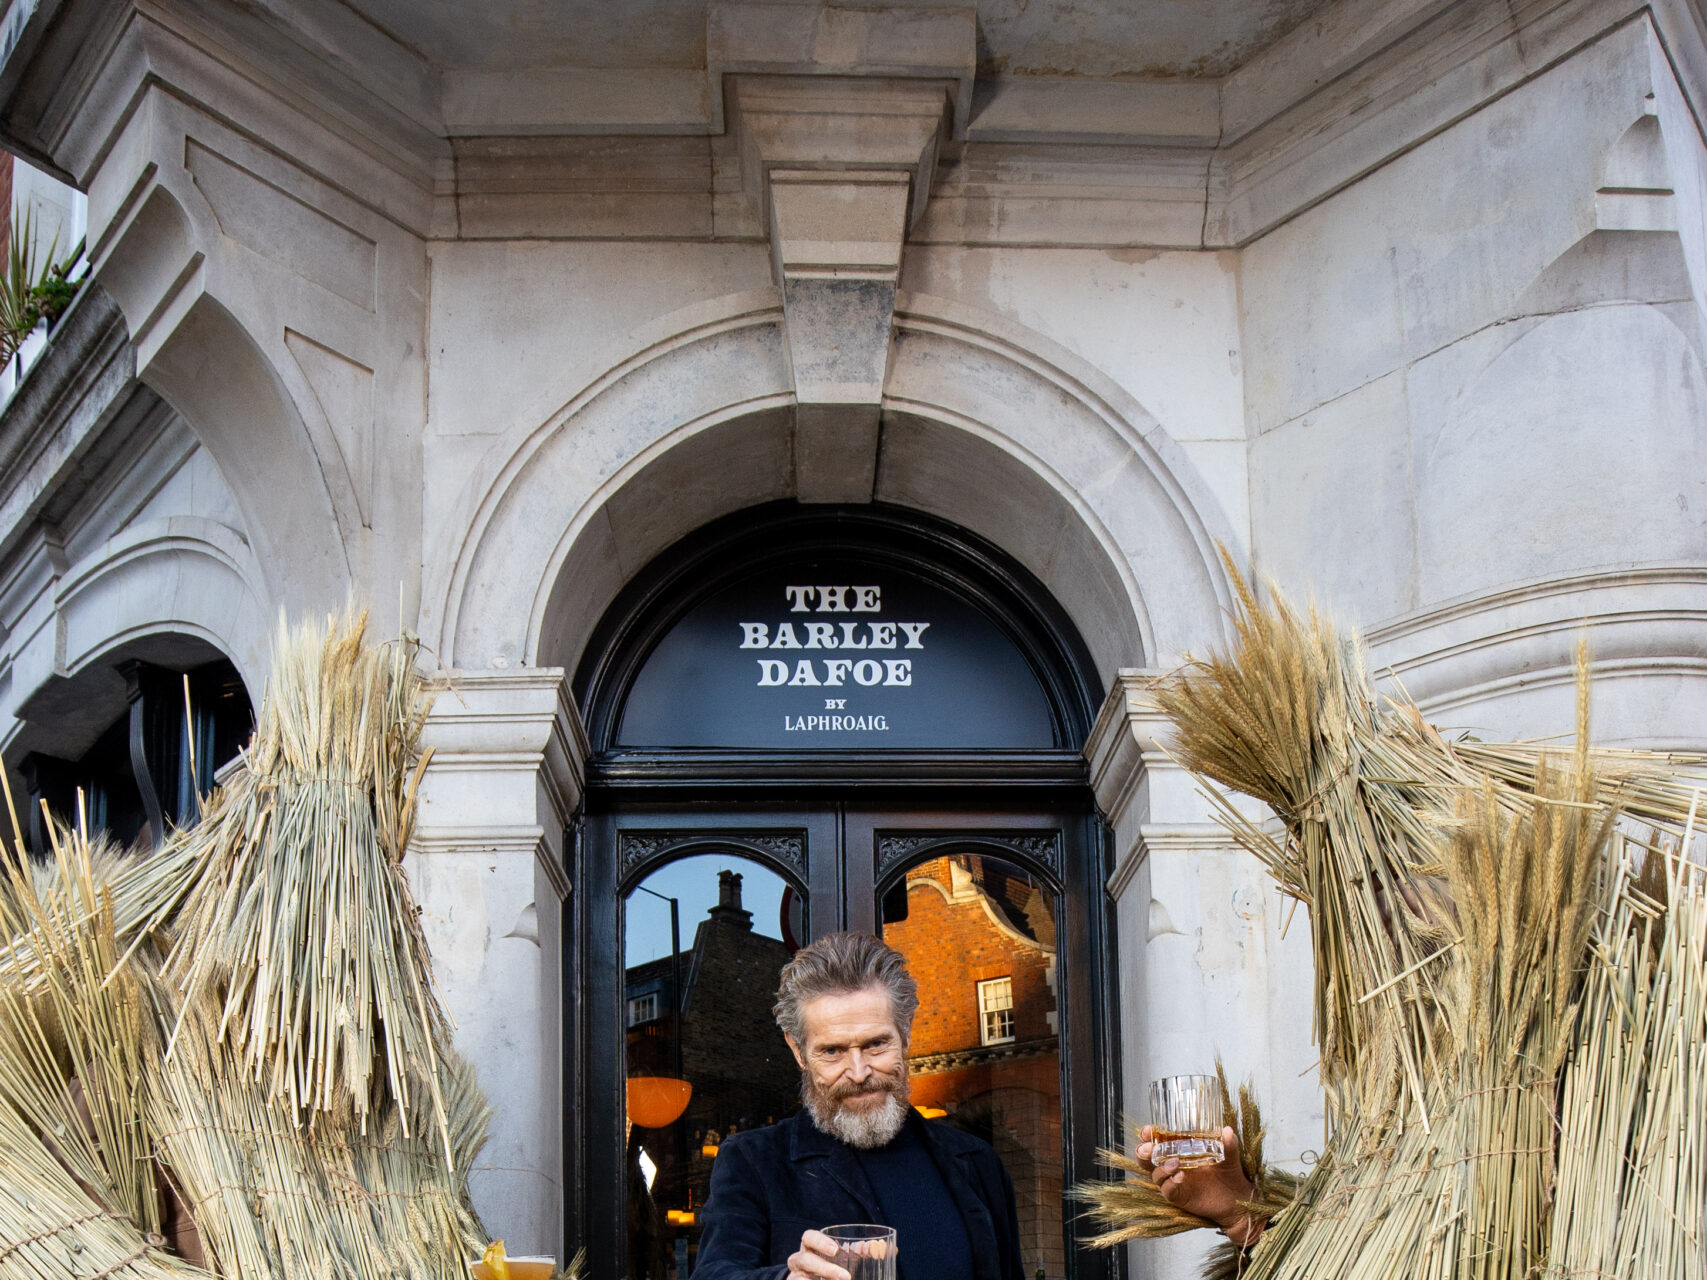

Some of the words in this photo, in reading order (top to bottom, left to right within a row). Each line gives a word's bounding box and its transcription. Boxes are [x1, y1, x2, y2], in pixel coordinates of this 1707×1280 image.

[786, 585, 881, 612] THE
[739, 622, 930, 649] BARLEY
[757, 659, 912, 686] DAFOE
[825, 699, 847, 709] BY
